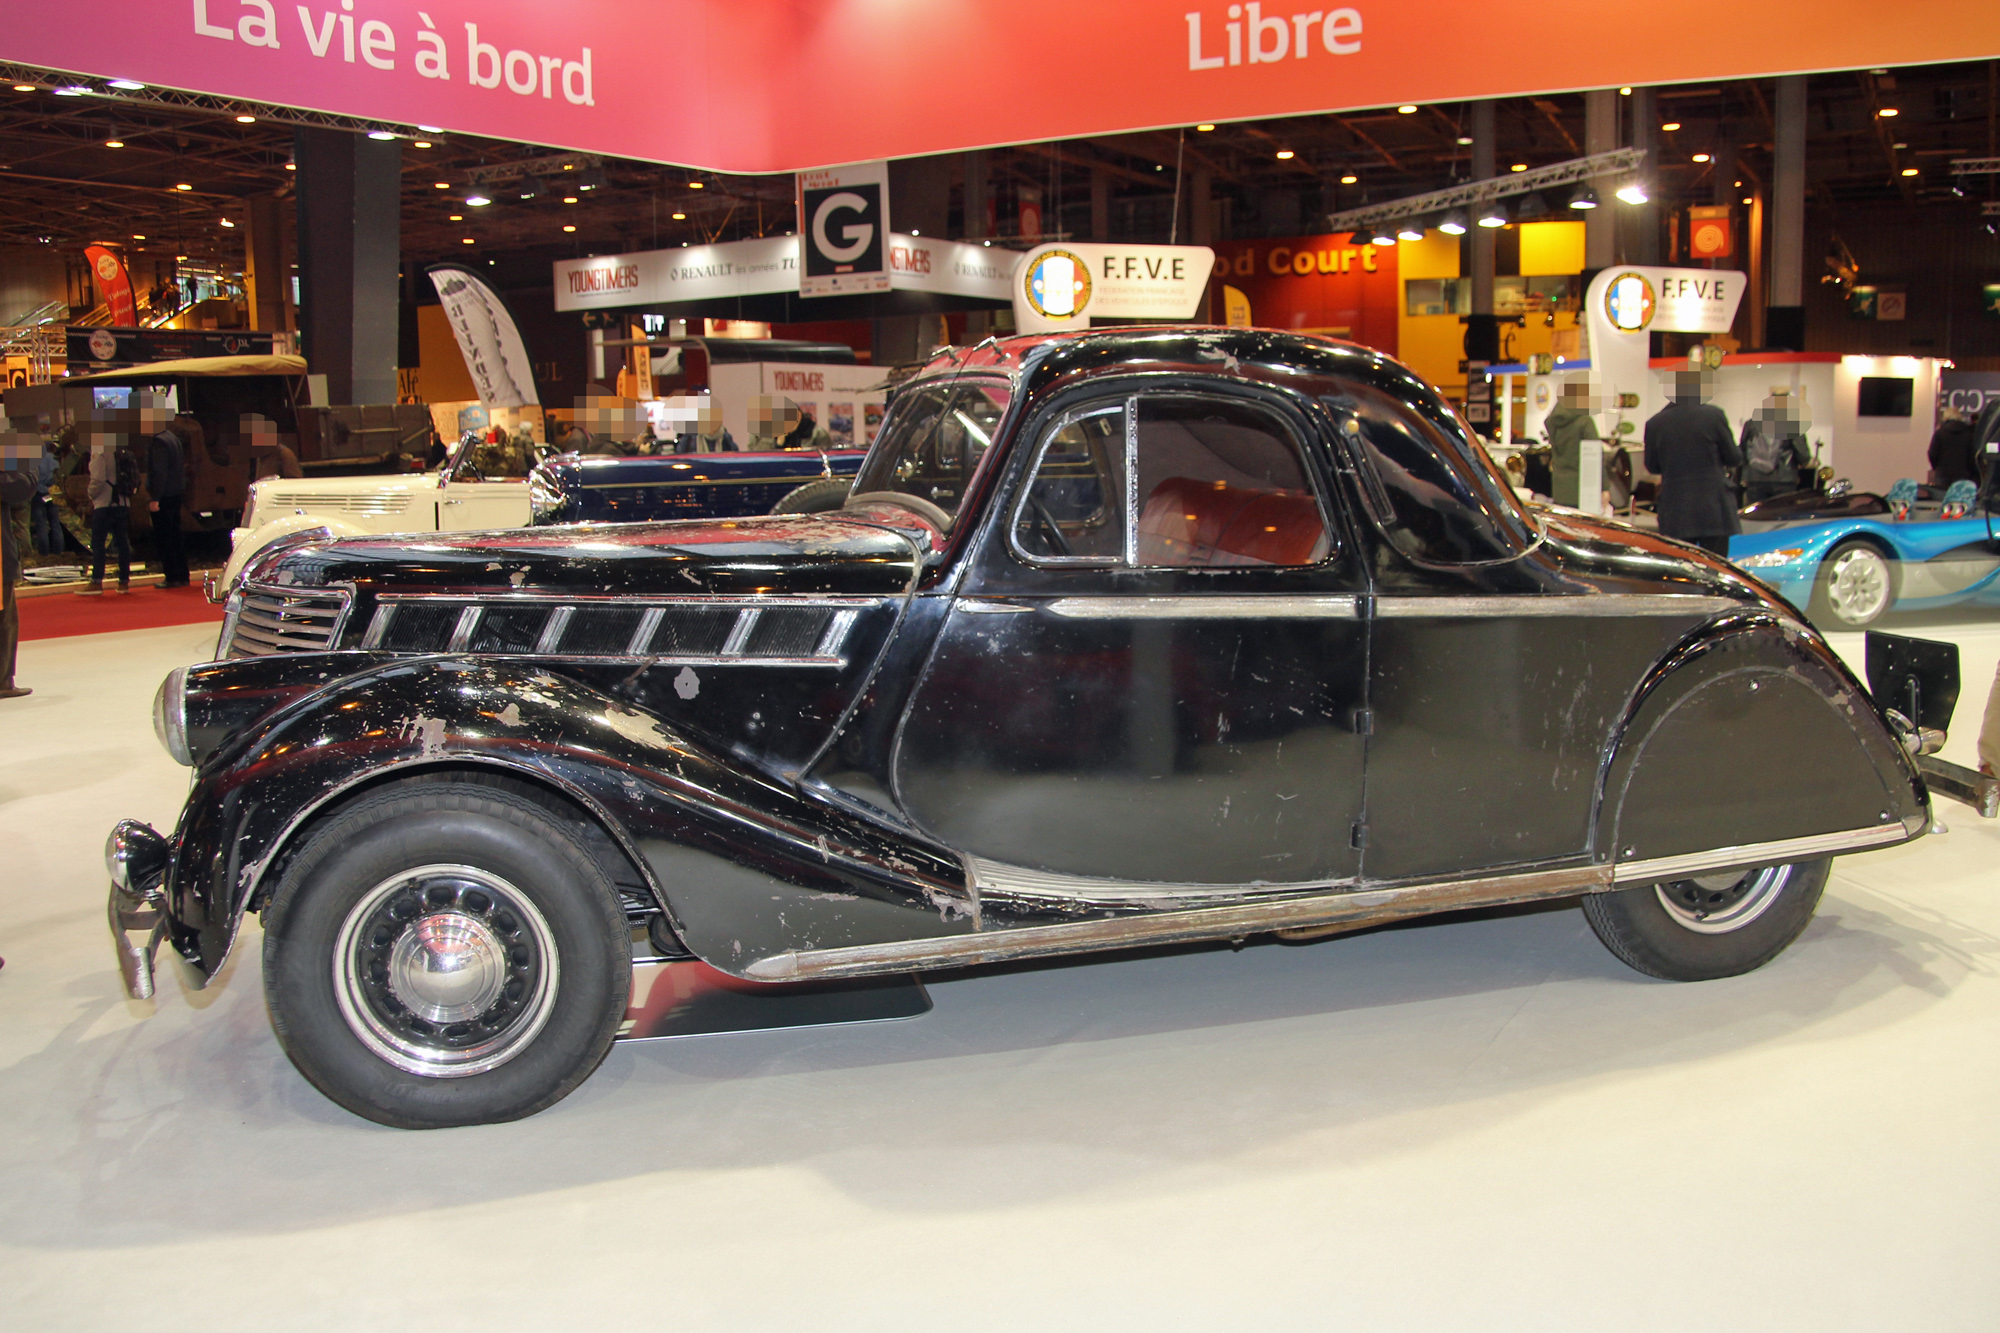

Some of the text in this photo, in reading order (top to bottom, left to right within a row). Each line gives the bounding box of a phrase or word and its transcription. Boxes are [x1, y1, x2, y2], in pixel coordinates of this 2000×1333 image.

[1185, 1, 1363, 71] Libre
[194, 0, 595, 106] La vie à bord
[812, 192, 873, 263] G
[681, 263, 733, 280] RENAULT
[782, 257, 798, 270] TU
[890, 247, 930, 274] NGTIMERS
[1103, 257, 1185, 280] F.F.V.E
[1213, 244, 1377, 277] od Court
[568, 265, 639, 293] YOUNGTIMERS
[1662, 278, 1725, 300] F.FV.E
[535, 361, 563, 382] UL
[773, 370, 824, 392] YOUNGTIMERS
